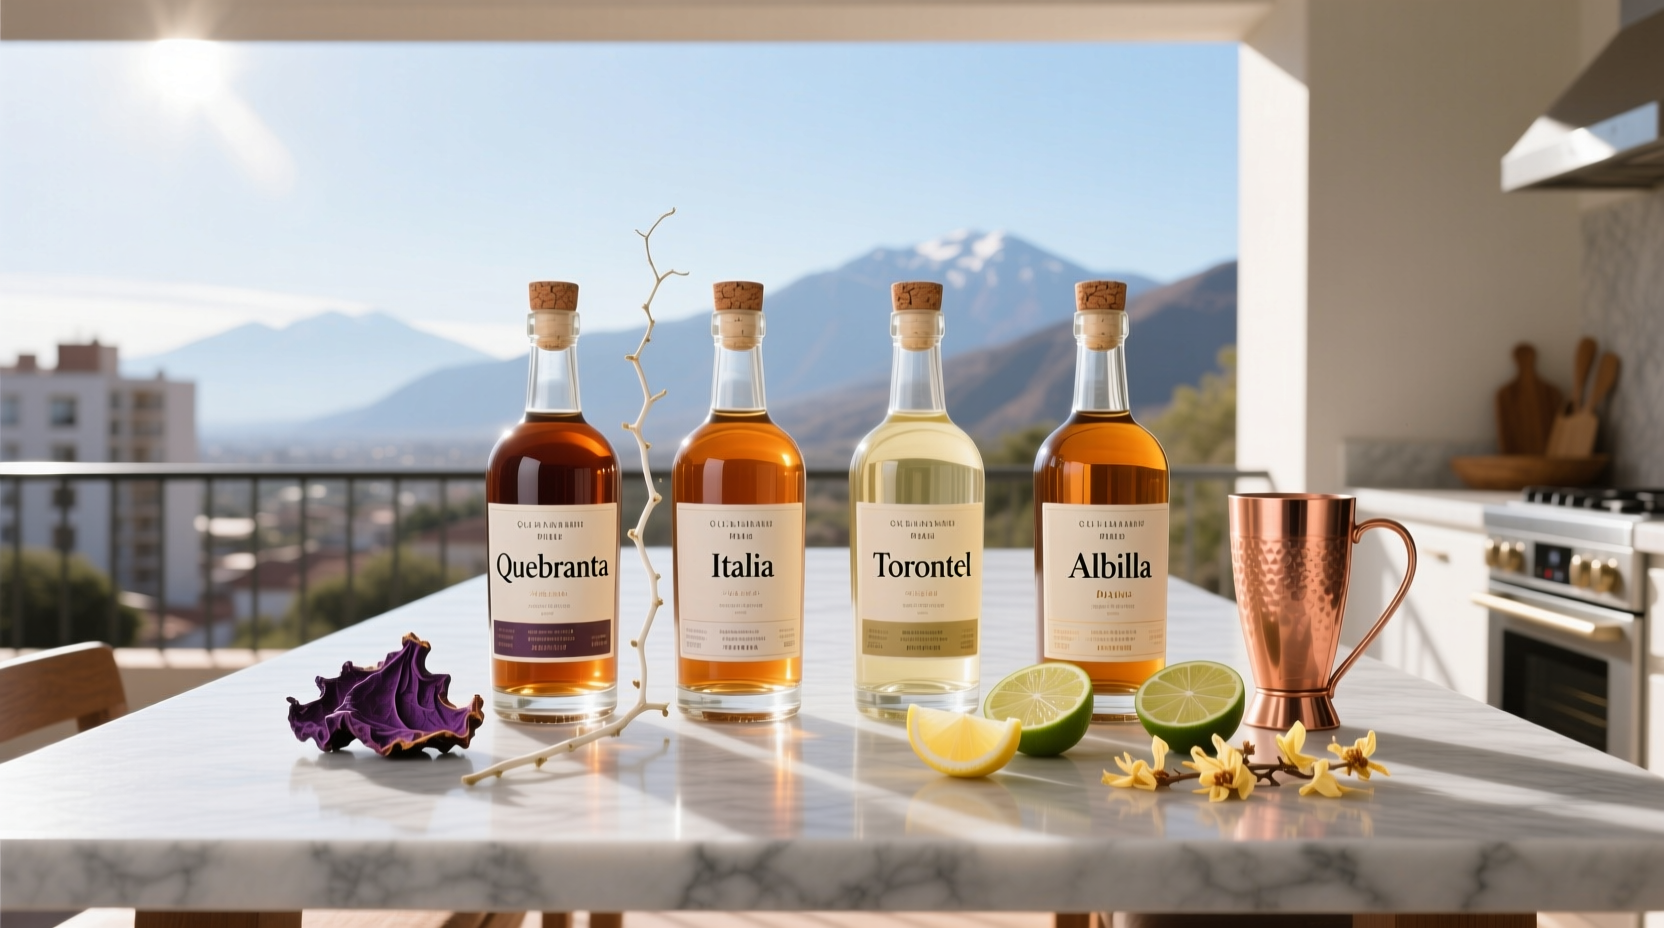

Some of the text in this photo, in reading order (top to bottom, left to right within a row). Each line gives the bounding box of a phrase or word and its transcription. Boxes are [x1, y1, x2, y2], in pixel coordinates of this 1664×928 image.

[496, 552, 609, 584] Quebranta
[711, 552, 775, 578] Italia
[872, 551, 972, 578] Torontel
[1068, 552, 1153, 579] Albilla
